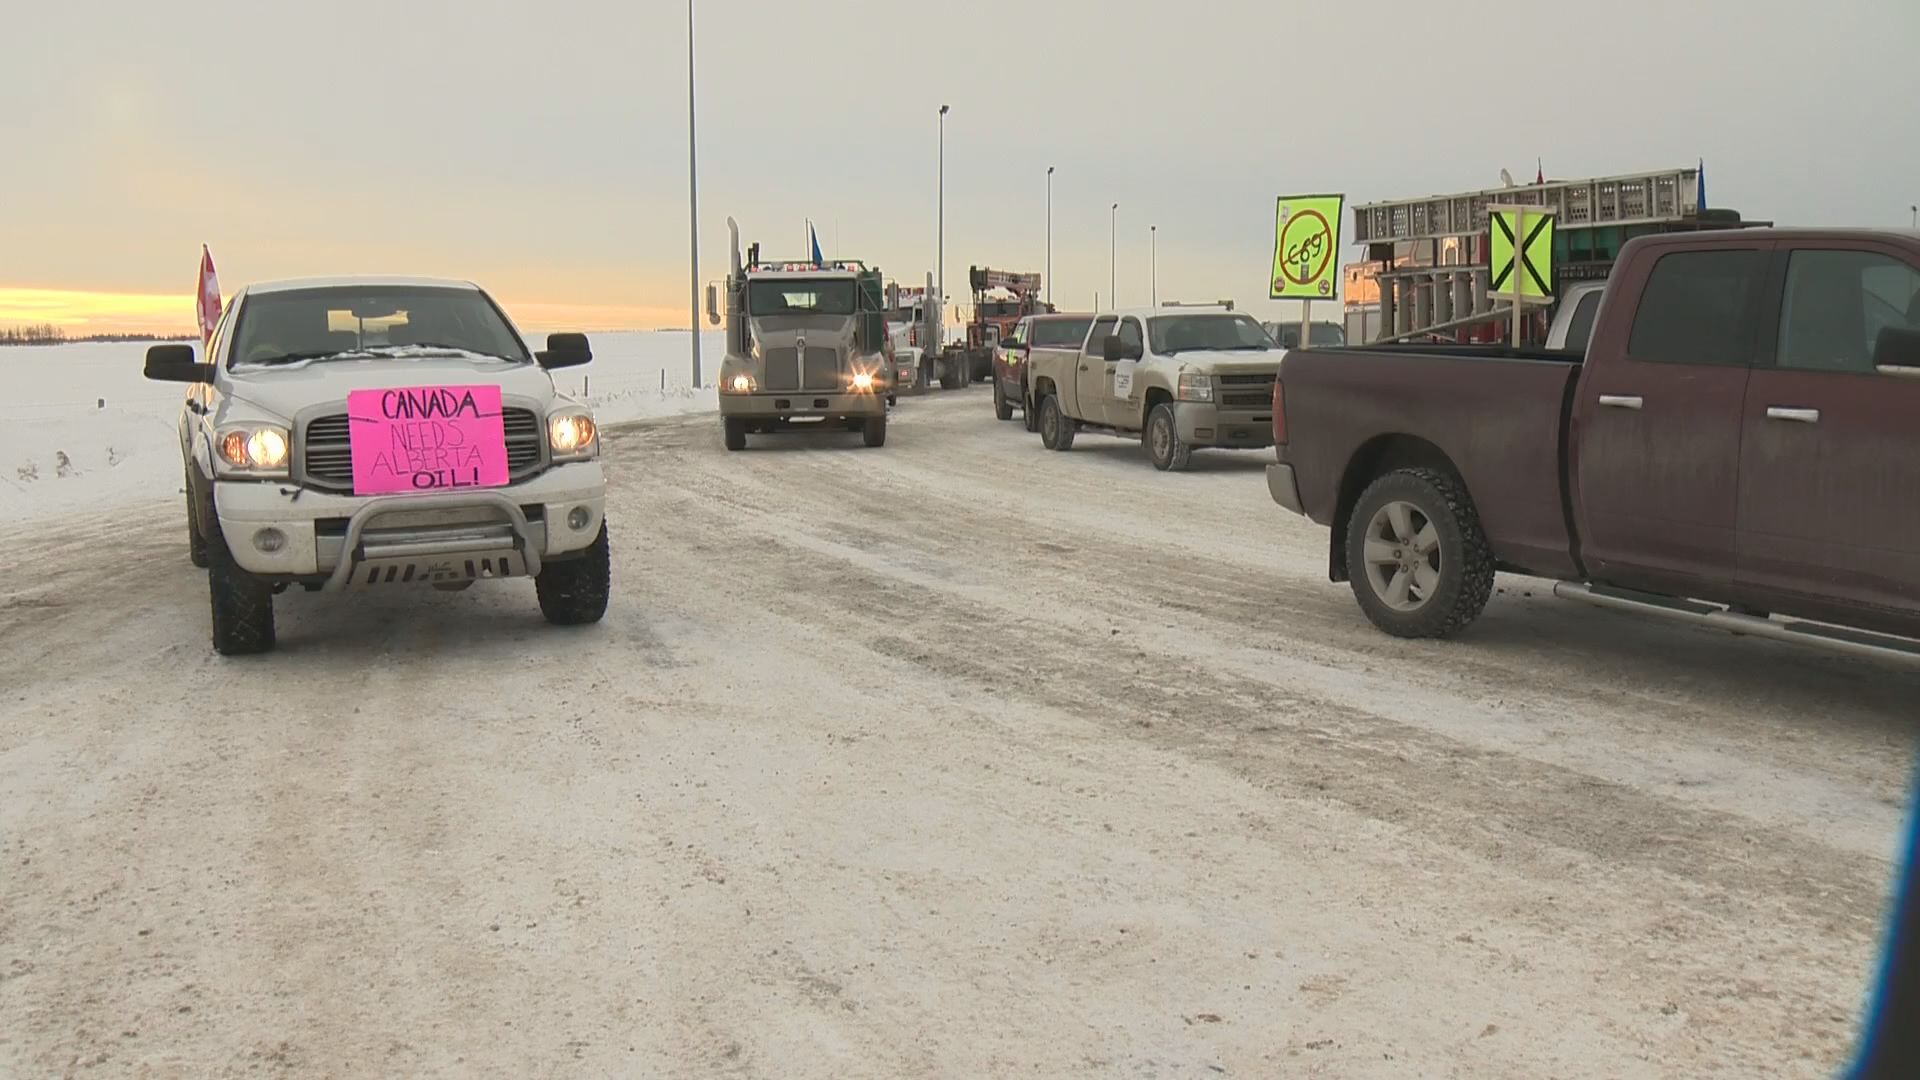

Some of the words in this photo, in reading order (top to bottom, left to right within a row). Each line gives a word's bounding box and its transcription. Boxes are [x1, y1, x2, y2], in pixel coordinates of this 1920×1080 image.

[382, 389, 480, 419] CANADA
[391, 420, 464, 450] NEEDS
[371, 445, 484, 475] ALBERTA
[412, 467, 479, 489] OIL!
